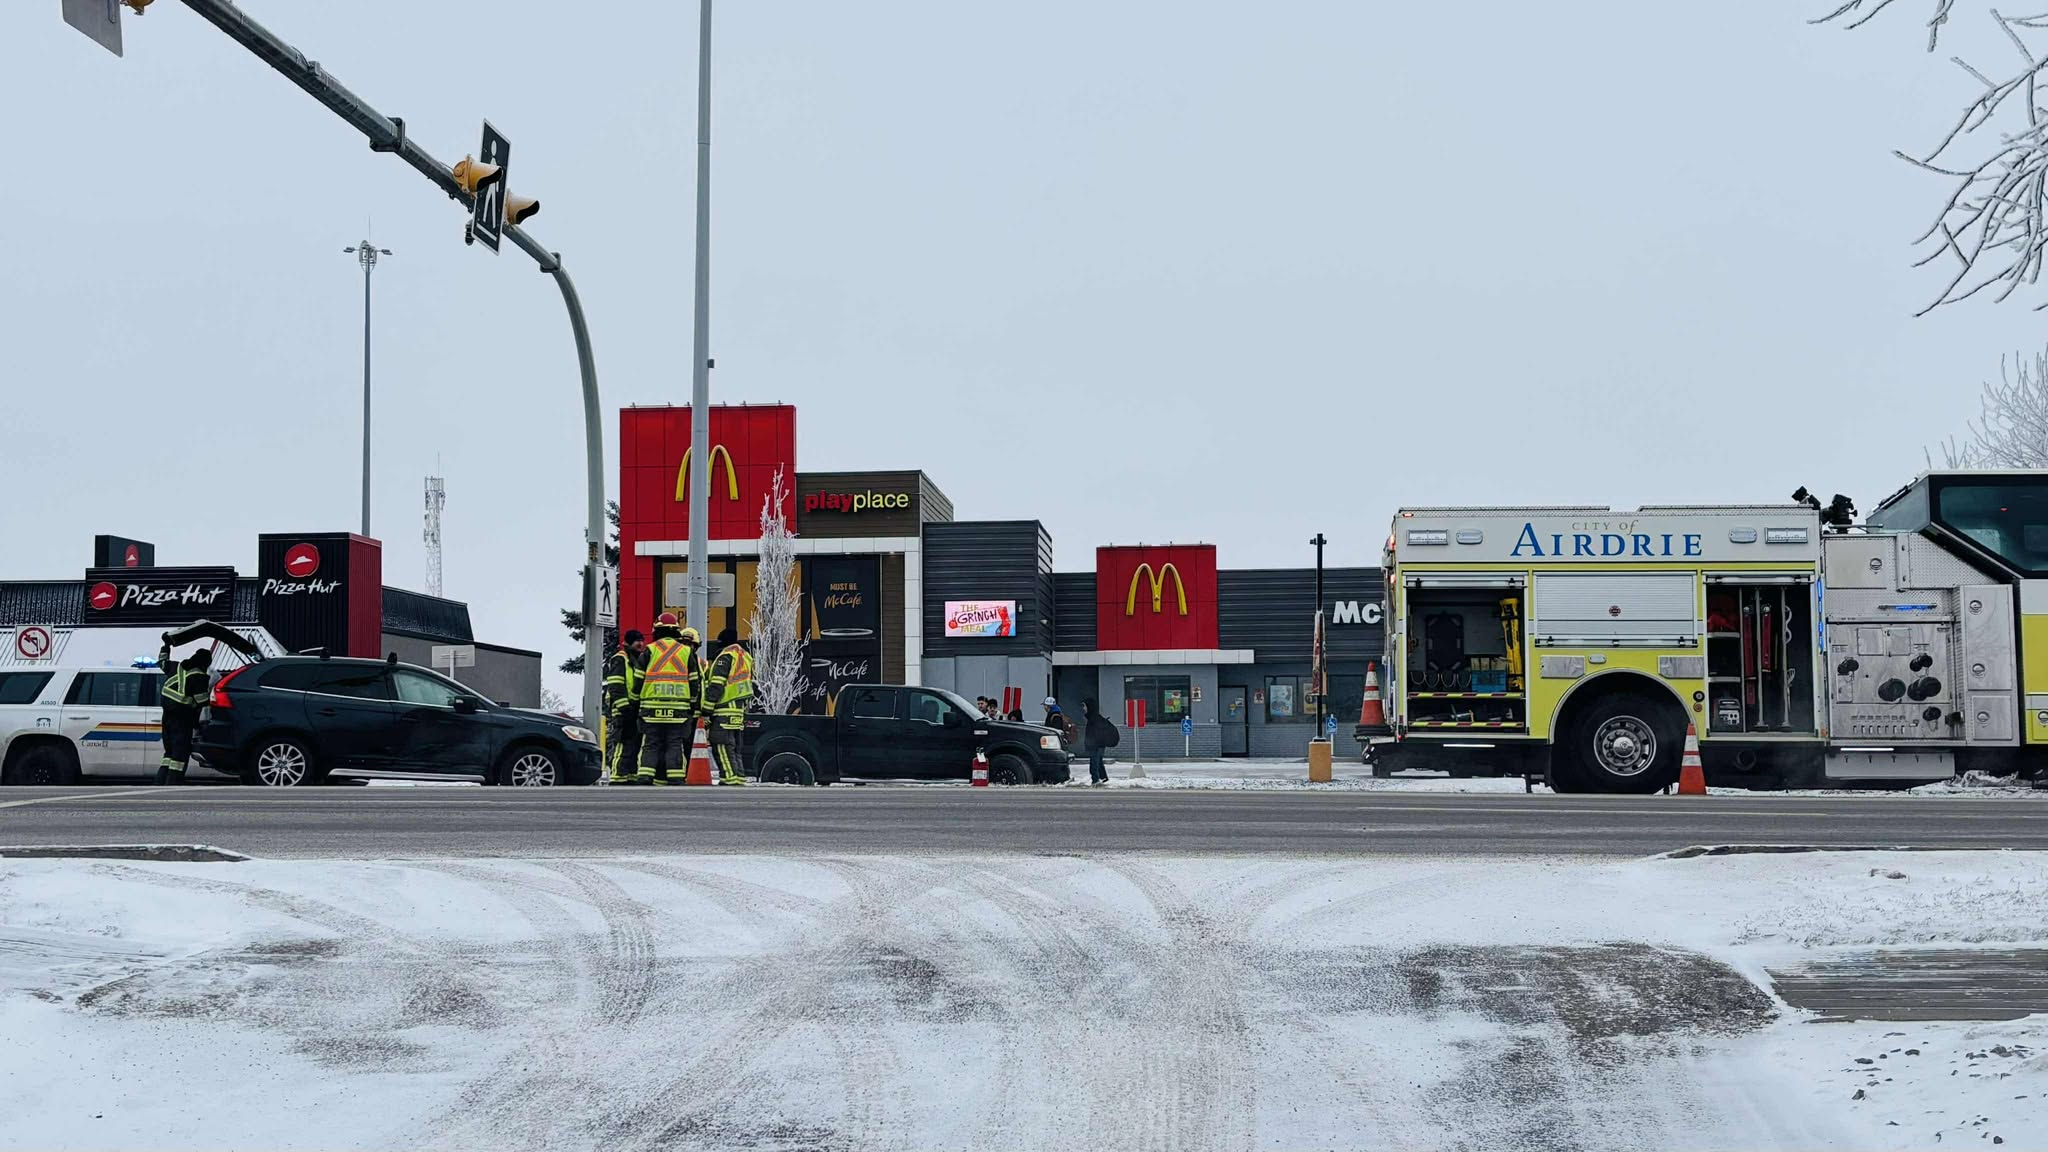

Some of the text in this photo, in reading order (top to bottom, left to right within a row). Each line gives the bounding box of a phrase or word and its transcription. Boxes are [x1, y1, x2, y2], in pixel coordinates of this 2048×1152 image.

[804, 489, 909, 513] playplace
[1571, 519, 1639, 536] CITY of
[1510, 522, 1702, 557] AIRDRIE
[121, 583, 226, 607] Pizza Hut
[262, 578, 342, 596] Pizza Hut
[829, 582, 847, 591] MUST
[960, 604, 979, 612] THE
[1332, 600, 1382, 624] Mc
[654, 683, 684, 696] FIRE
[737, 681, 751, 694] FI
